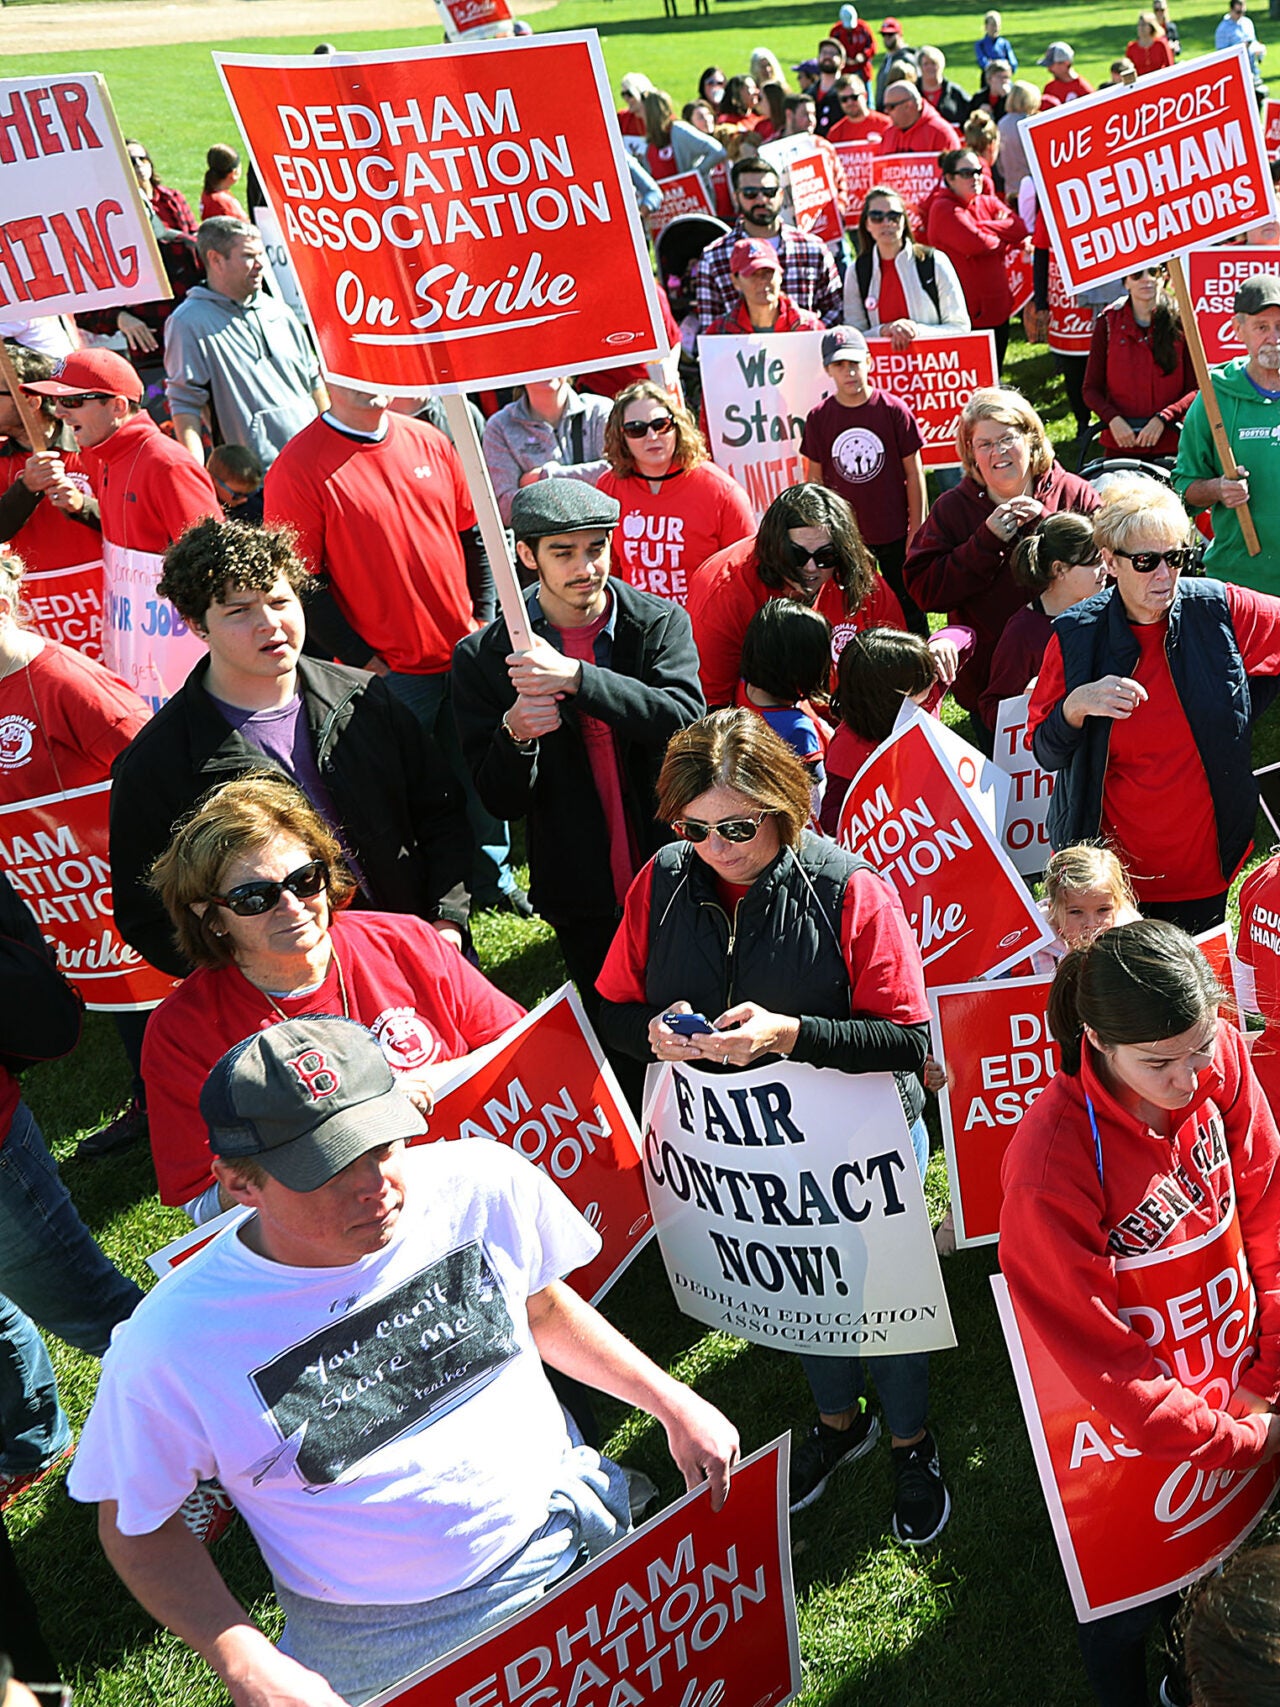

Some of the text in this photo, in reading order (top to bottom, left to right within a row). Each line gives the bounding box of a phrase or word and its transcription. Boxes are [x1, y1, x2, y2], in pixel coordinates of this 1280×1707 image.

[278, 88, 519, 151] DEDHAM
[1048, 75, 1233, 168] WE SUPPORT
[273, 134, 575, 200] EDUCATION
[1055, 120, 1248, 229] DEDHAM
[285, 181, 611, 252] ASSOCIATION
[1071, 174, 1256, 271] EDUCATORS
[335, 252, 577, 330] On Strike
[737, 348, 785, 389] We
[722, 400, 807, 447] Stan
[623, 540, 685, 569] FUT
[140, 599, 190, 637] JOB
[671, 1062, 805, 1146] FAIR
[644, 1124, 906, 1226] CONTRACT
[709, 1229, 848, 1297] NOW!
[674, 1272, 938, 1327] DEDHAM EDUCATION
[720, 1312, 888, 1344] ASSOCIATION
[305, 1283, 449, 1386] You can't
[415, 1361, 472, 1400] teacher
[455, 1532, 697, 1707] EDHAM
